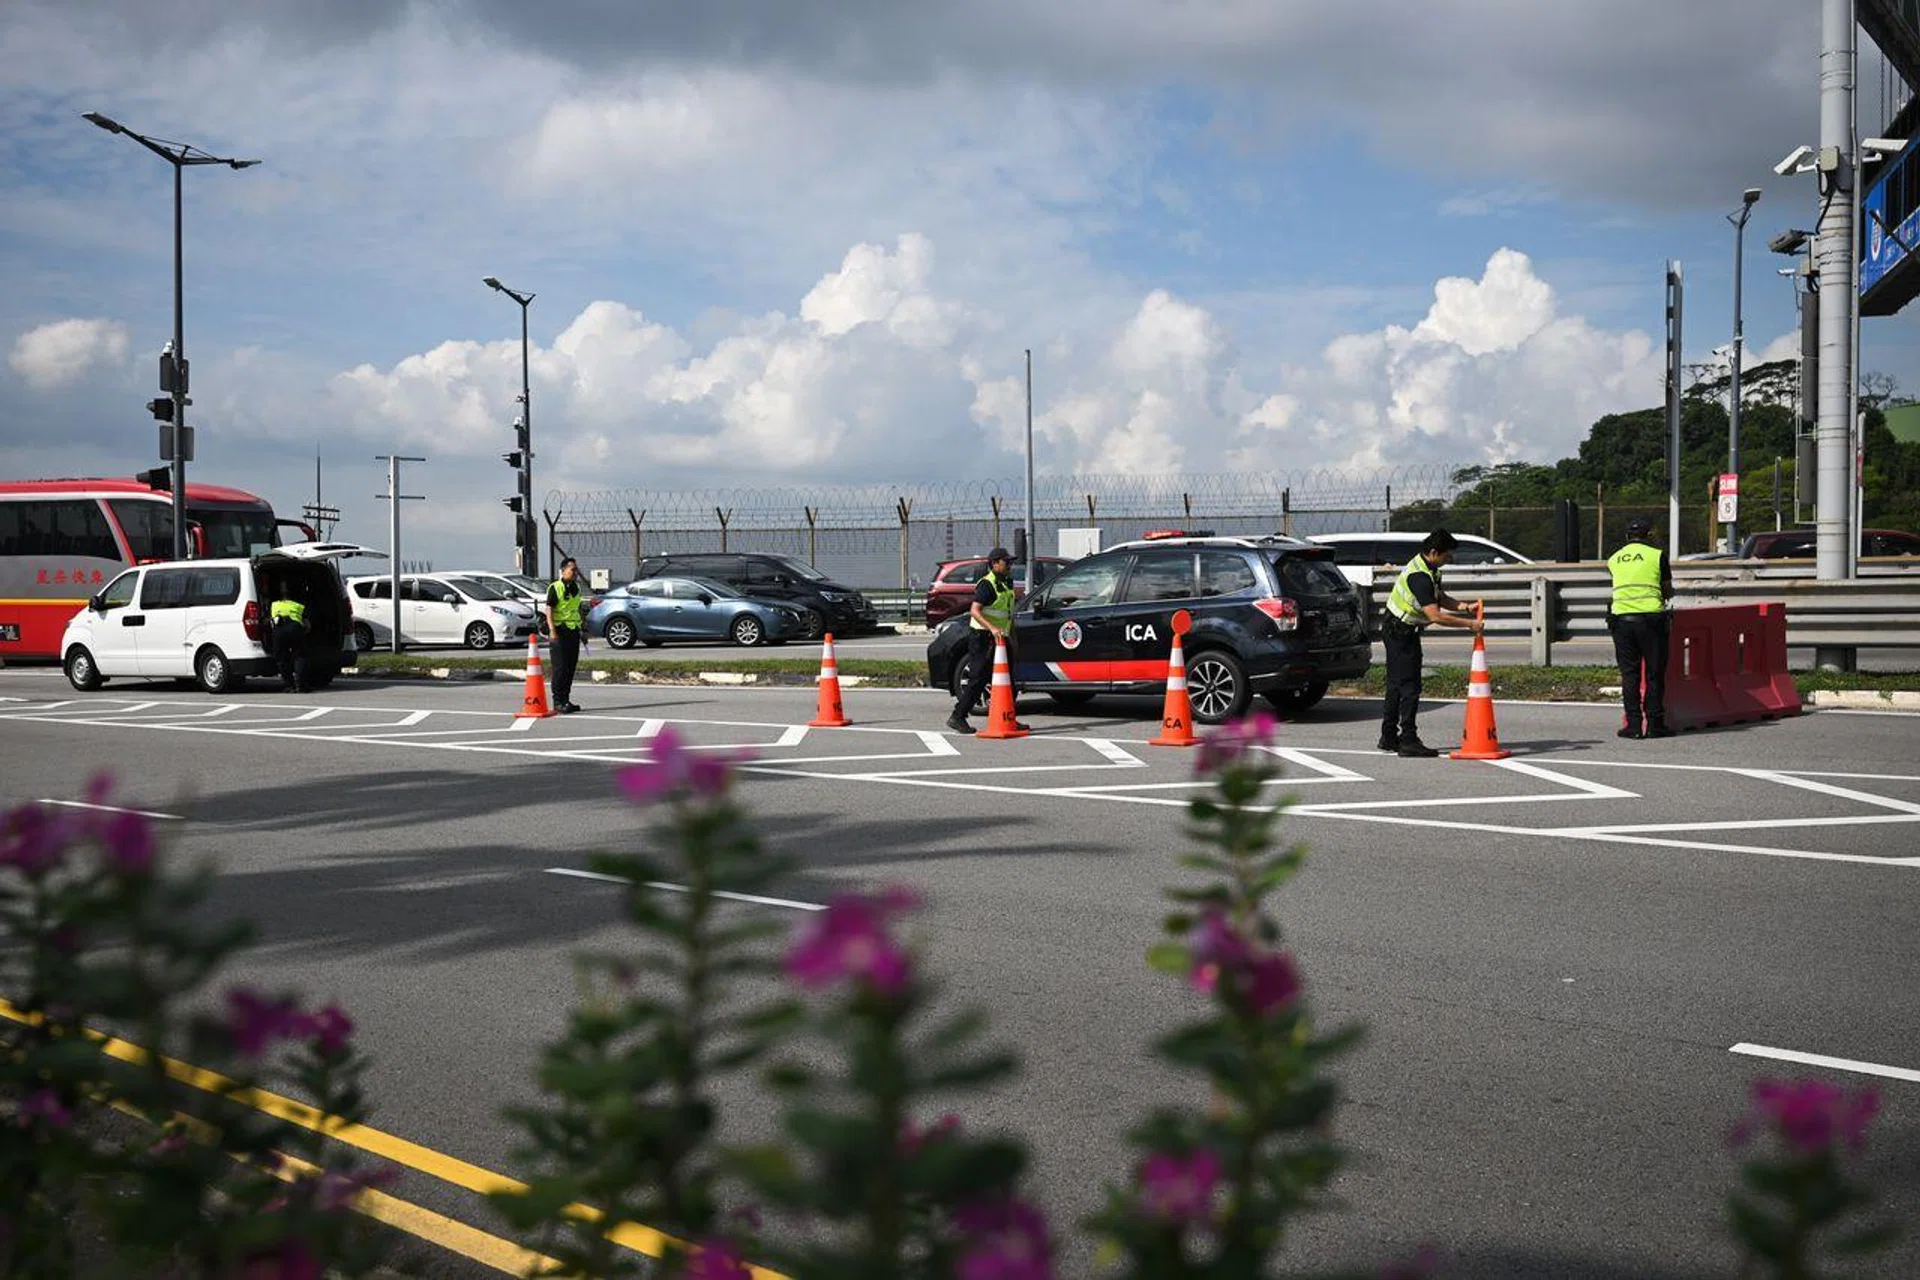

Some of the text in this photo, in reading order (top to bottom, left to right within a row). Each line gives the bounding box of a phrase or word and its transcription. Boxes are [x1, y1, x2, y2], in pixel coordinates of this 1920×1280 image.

[1616, 553, 1644, 564] ICA
[1125, 624, 1158, 641] ICA
[524, 696, 541, 706] CA
[832, 701, 843, 713] IC
[1002, 711, 1016, 722] IC
[1163, 717, 1183, 730] CA
[1486, 727, 1498, 741] IC
